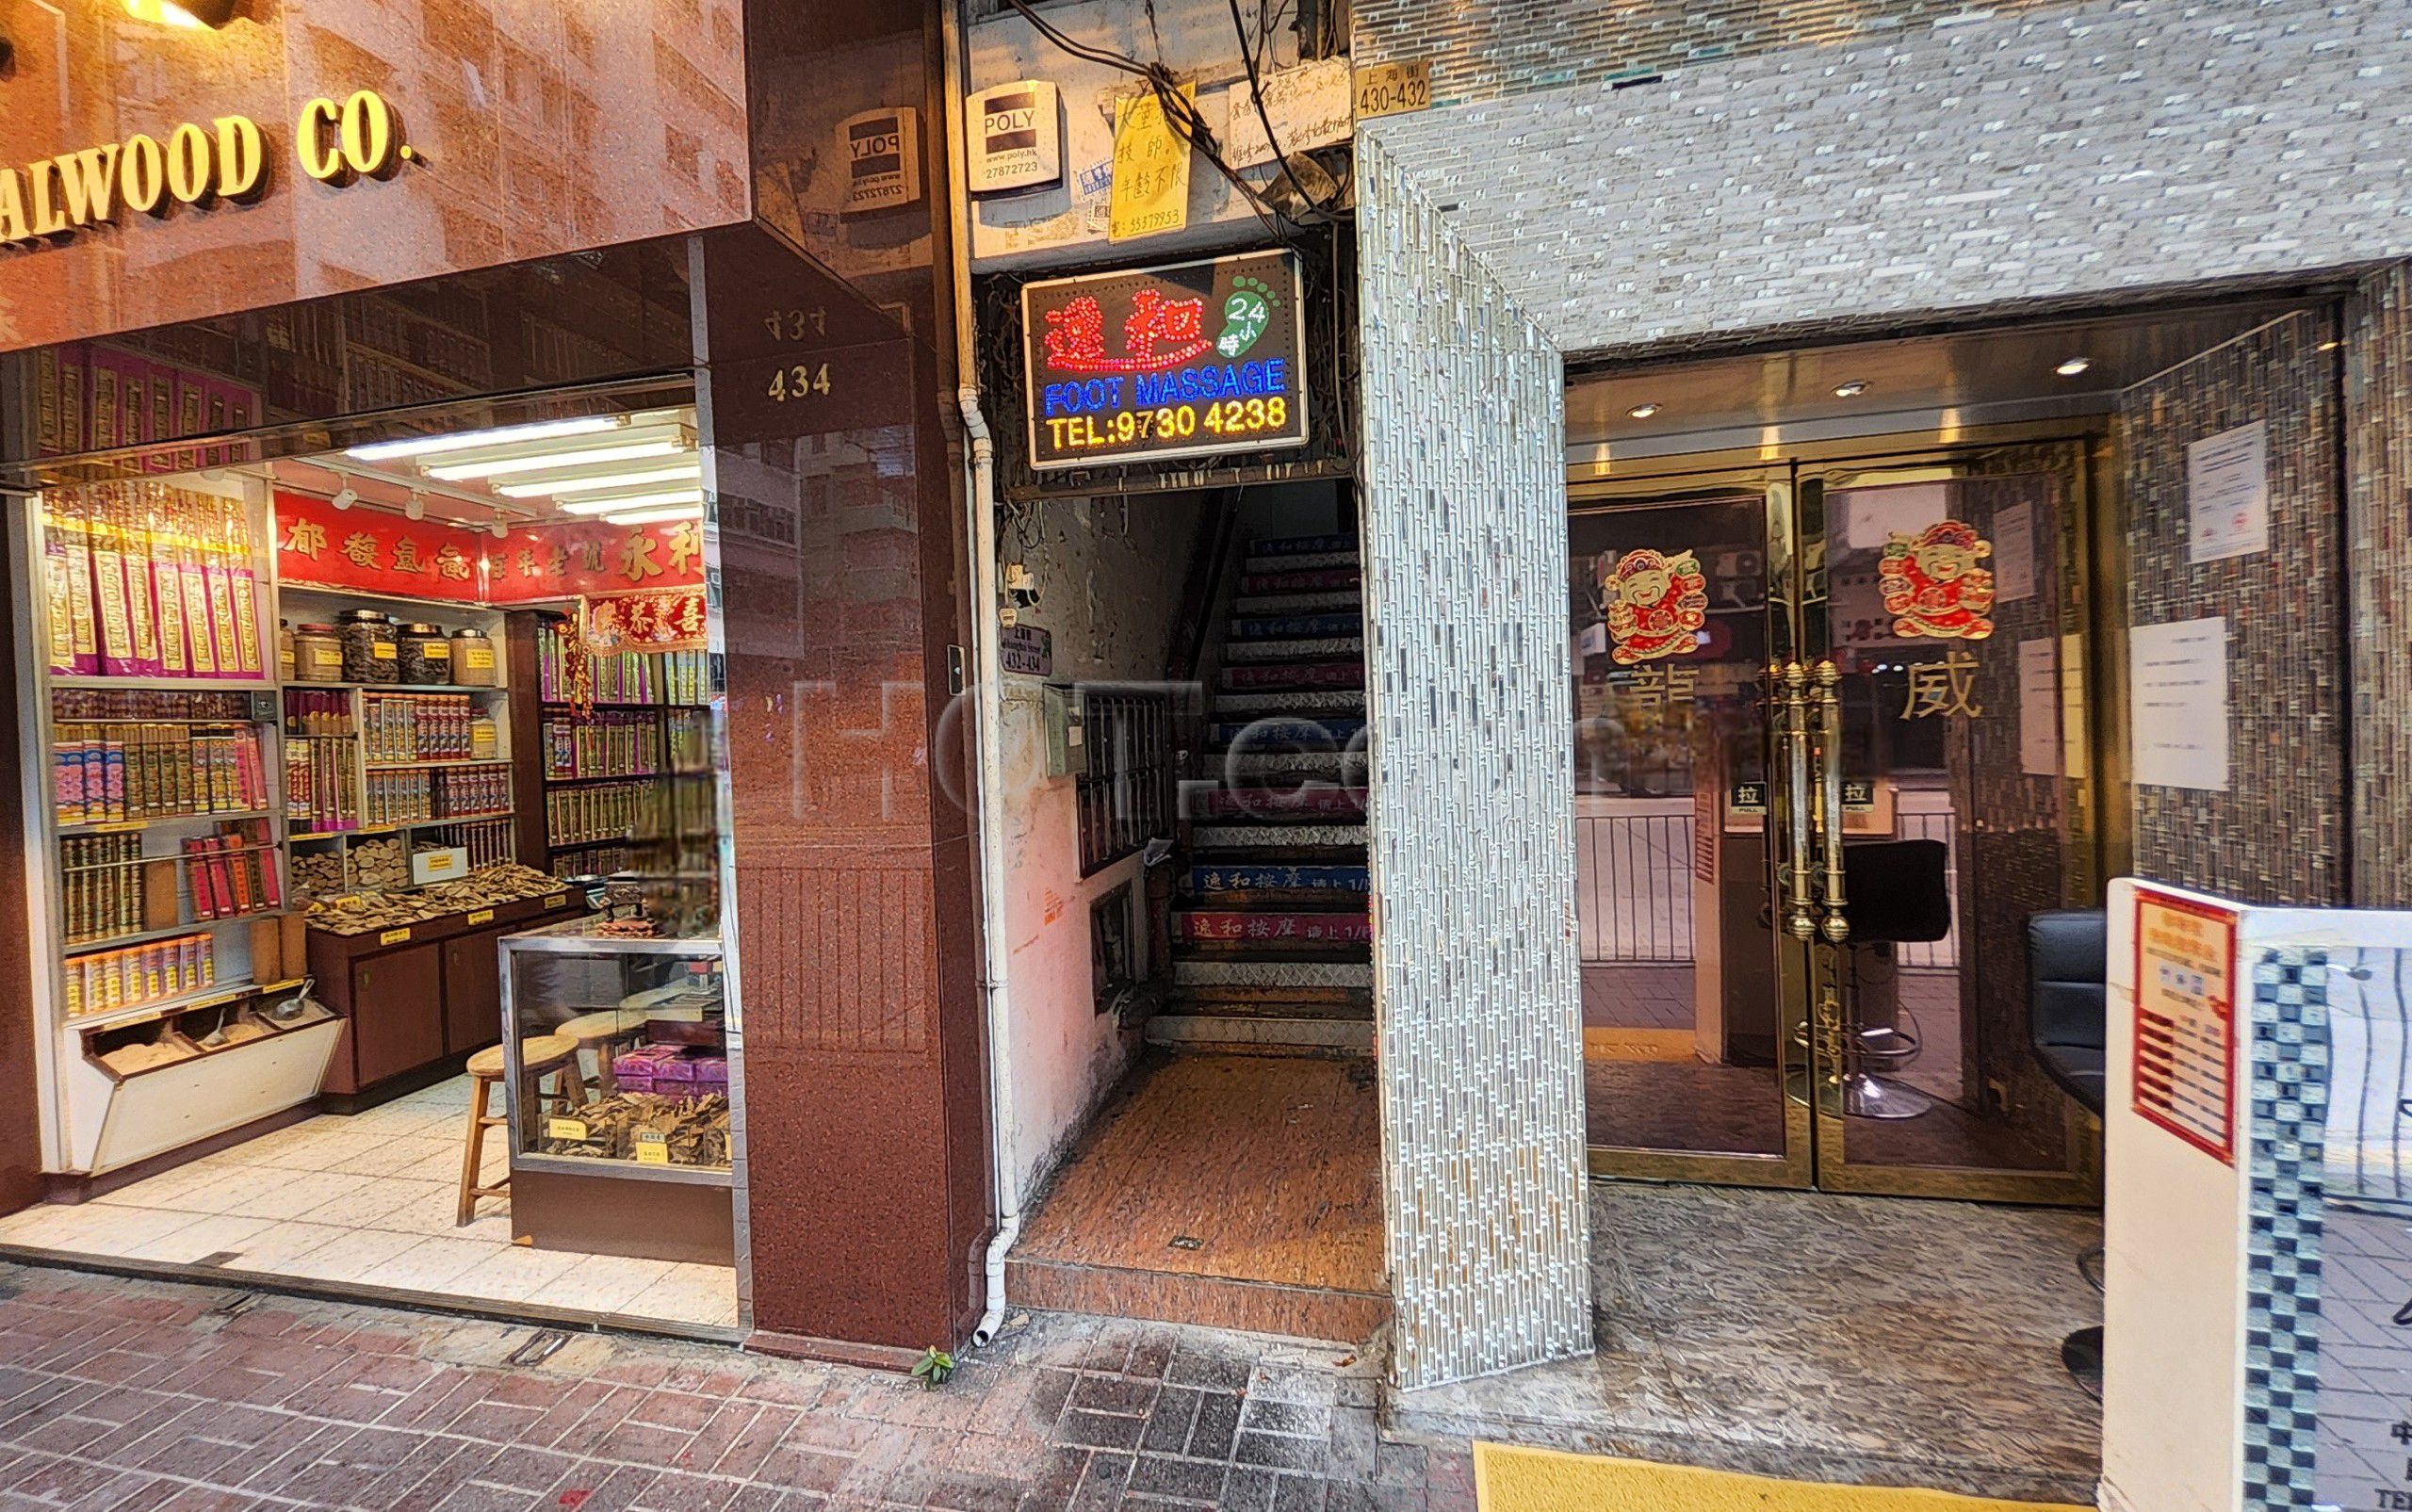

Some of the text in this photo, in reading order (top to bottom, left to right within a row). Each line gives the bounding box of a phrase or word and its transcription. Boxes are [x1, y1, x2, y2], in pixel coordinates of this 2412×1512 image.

[1360, 80, 1426, 114] 430-432
[296, 89, 413, 180] CO.
[984, 110, 1035, 135] POLY
[986, 151, 1037, 163] www.poly.hk
[986, 163, 1037, 179] 27872723
[1228, 298, 1266, 321] 24
[768, 363, 831, 402] 434
[1045, 357, 1286, 416] FOOT MASSAGE
[1204, 396, 1286, 436] 4238
[1899, 650, 1983, 722] 威
[1737, 786, 1759, 804] 拉
[1844, 784, 1867, 802] 拉
